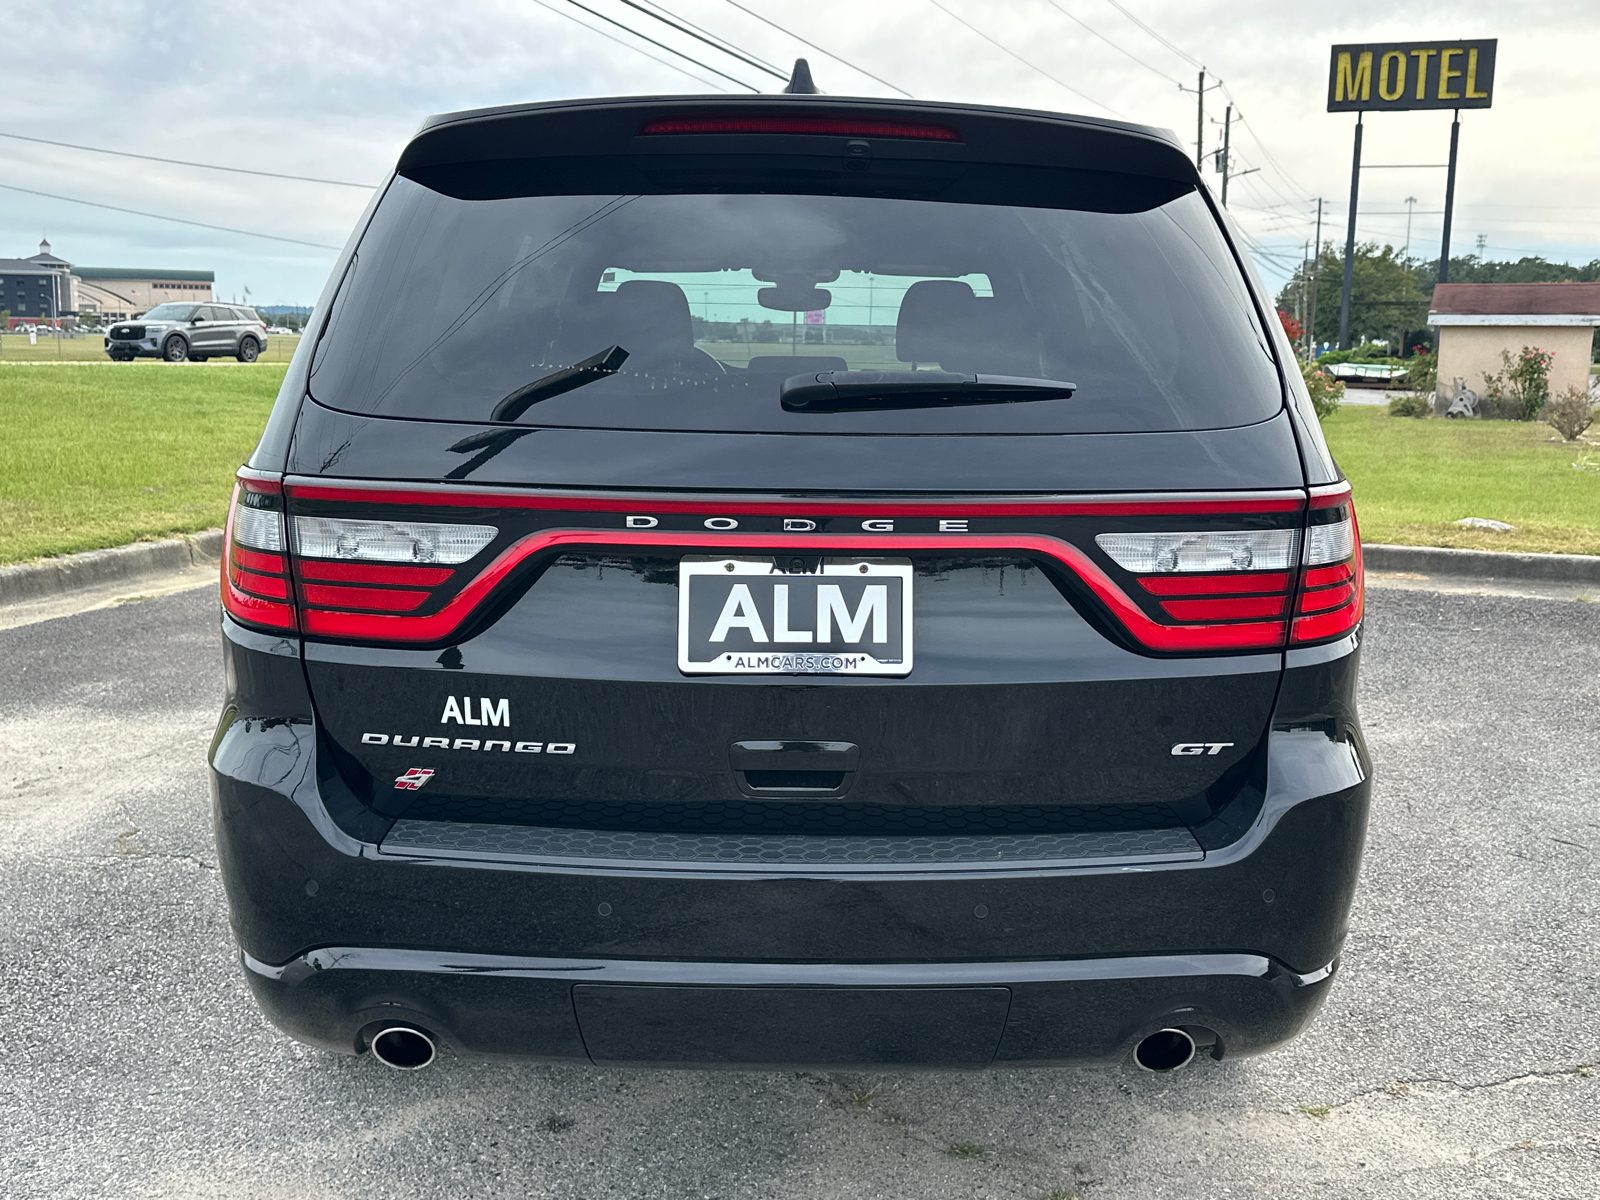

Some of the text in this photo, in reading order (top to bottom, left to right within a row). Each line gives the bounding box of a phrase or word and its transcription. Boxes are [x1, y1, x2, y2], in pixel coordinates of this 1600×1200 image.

[1335, 47, 1488, 102] MOTEL
[625, 515, 969, 532] DODGE
[708, 583, 888, 643] ALM
[734, 656, 857, 669] ALMCARS.COM
[441, 695, 510, 727] ALM
[361, 732, 576, 754] DURANGO
[1171, 742, 1235, 756] GT
